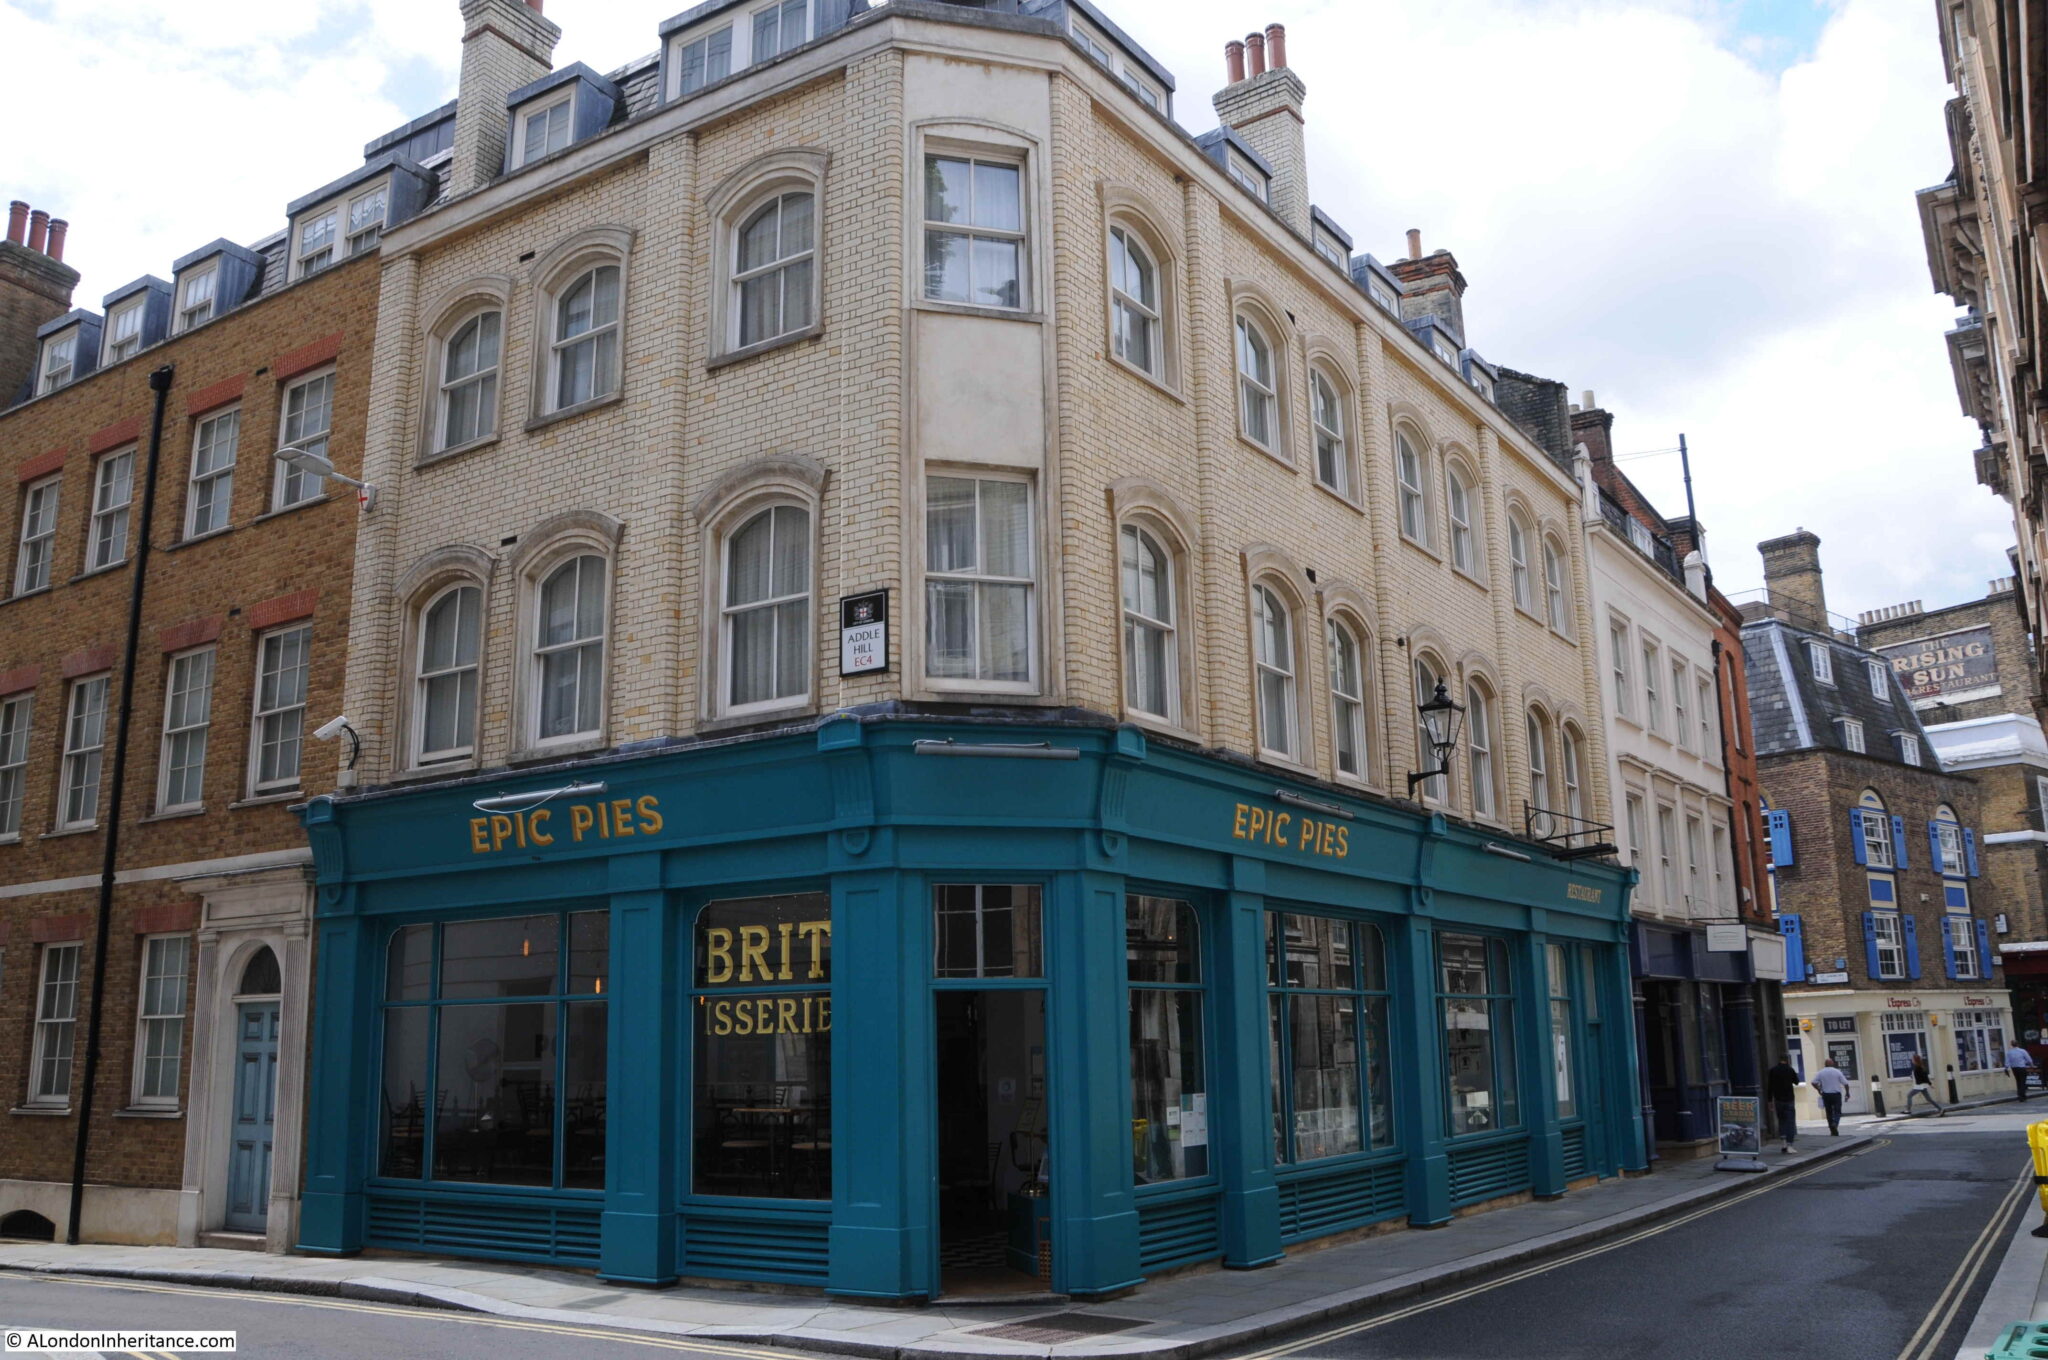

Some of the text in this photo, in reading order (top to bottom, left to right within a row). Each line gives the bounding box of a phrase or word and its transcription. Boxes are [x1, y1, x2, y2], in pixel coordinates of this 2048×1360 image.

[848, 629, 880, 644] ADDLE
[853, 643, 873, 655] HILL
[1919, 638, 1949, 651] THE
[854, 655, 873, 667] EC4
[1891, 642, 1984, 672] RISING
[1913, 663, 1965, 685] SUN
[469, 795, 664, 853] EPIC PIES
[1233, 803, 1349, 859] EPIC PIES
[705, 920, 831, 984] BRIT
[1827, 1020, 1851, 1030] TO LET
[1722, 1101, 1754, 1111] BEER
